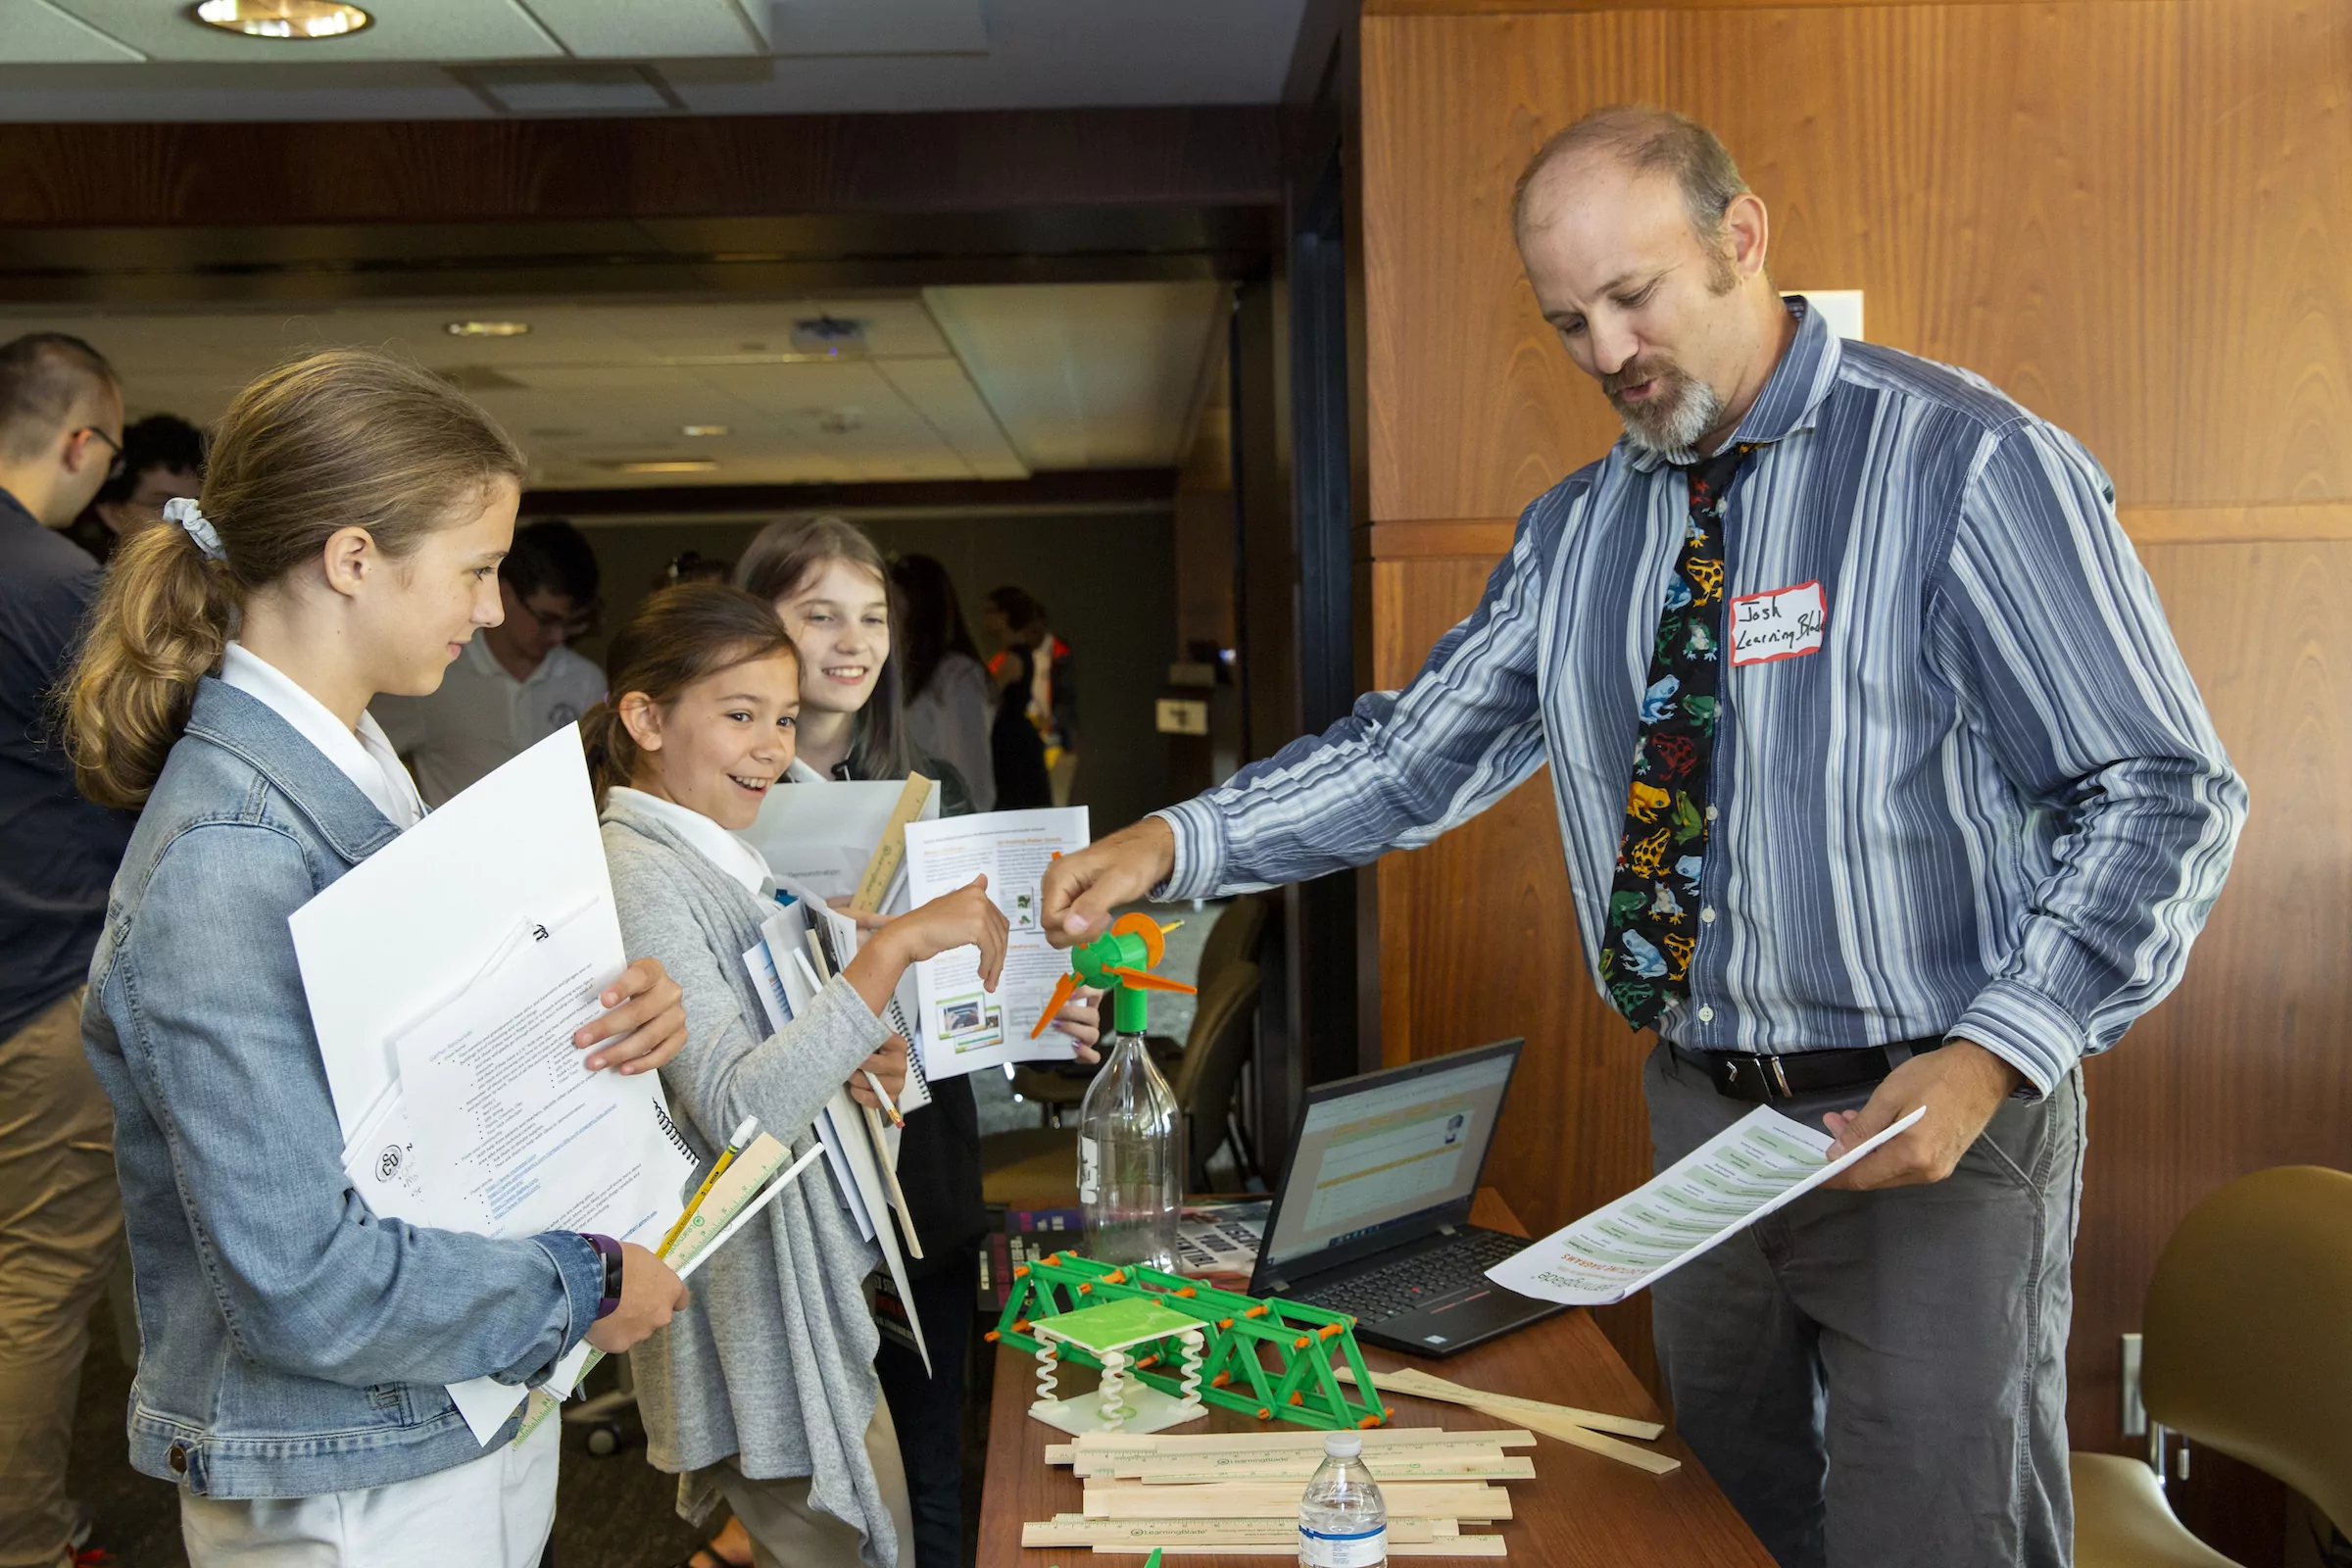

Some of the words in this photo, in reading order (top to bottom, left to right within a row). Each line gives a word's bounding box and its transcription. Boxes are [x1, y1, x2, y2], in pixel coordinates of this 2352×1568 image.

[1739, 596, 1782, 622] Josh
[1736, 629, 1795, 651] Learning
[1561, 1253, 1606, 1270] DIAGRAMS
[1230, 1456, 1289, 1465] LearningBlade
